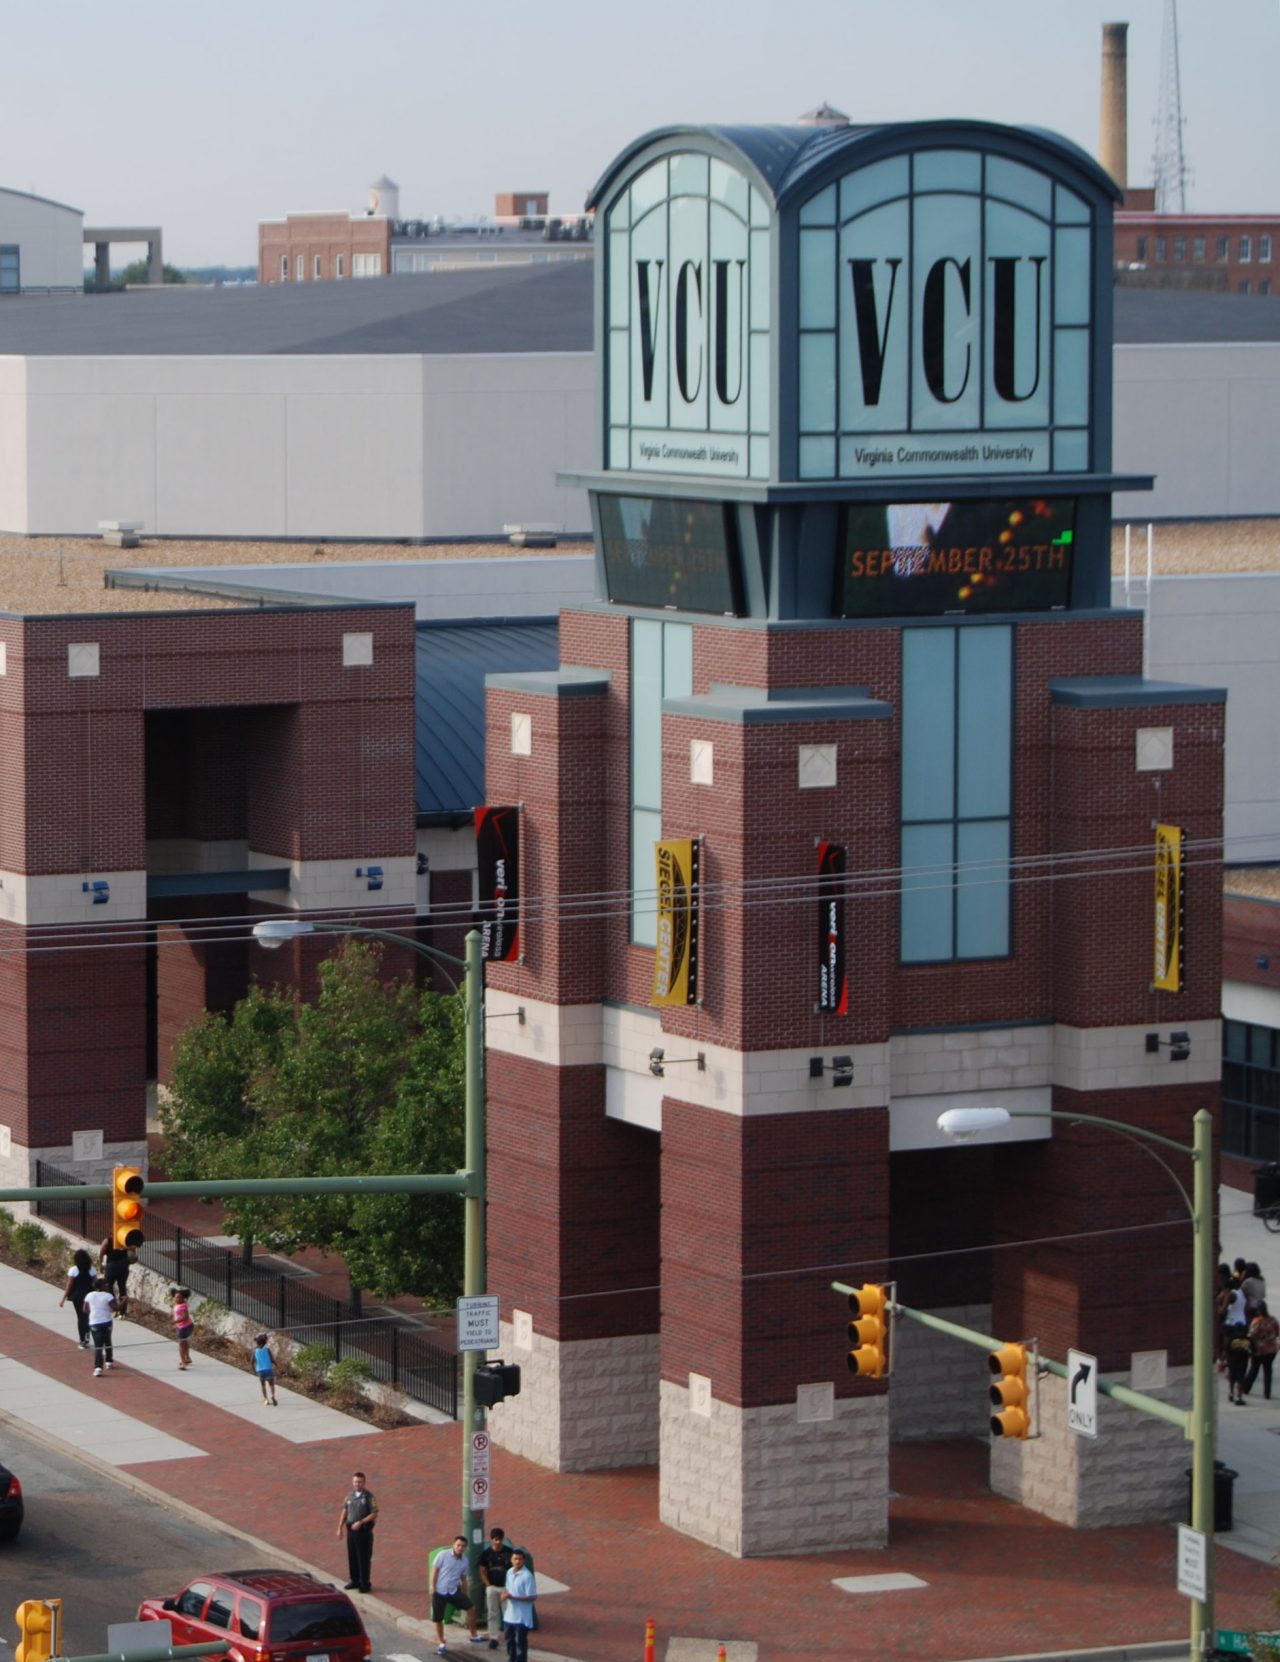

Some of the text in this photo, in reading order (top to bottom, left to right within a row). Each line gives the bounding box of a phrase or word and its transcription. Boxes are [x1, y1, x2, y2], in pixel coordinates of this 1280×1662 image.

[635, 259, 746, 405] VCU
[847, 255, 1048, 407] VCU
[854, 443, 1034, 467] Virginia Commonwealth University
[1004, 544, 1065, 571] 25TH
[481, 920, 491, 958] ARENA
[656, 847, 672, 997] SIEGEL CENTER
[1155, 901, 1166, 980] CENTER
[820, 963, 829, 1007] ARENA
[467, 1318, 489, 1328] MUST
[1068, 1408, 1094, 1428] ONLY
